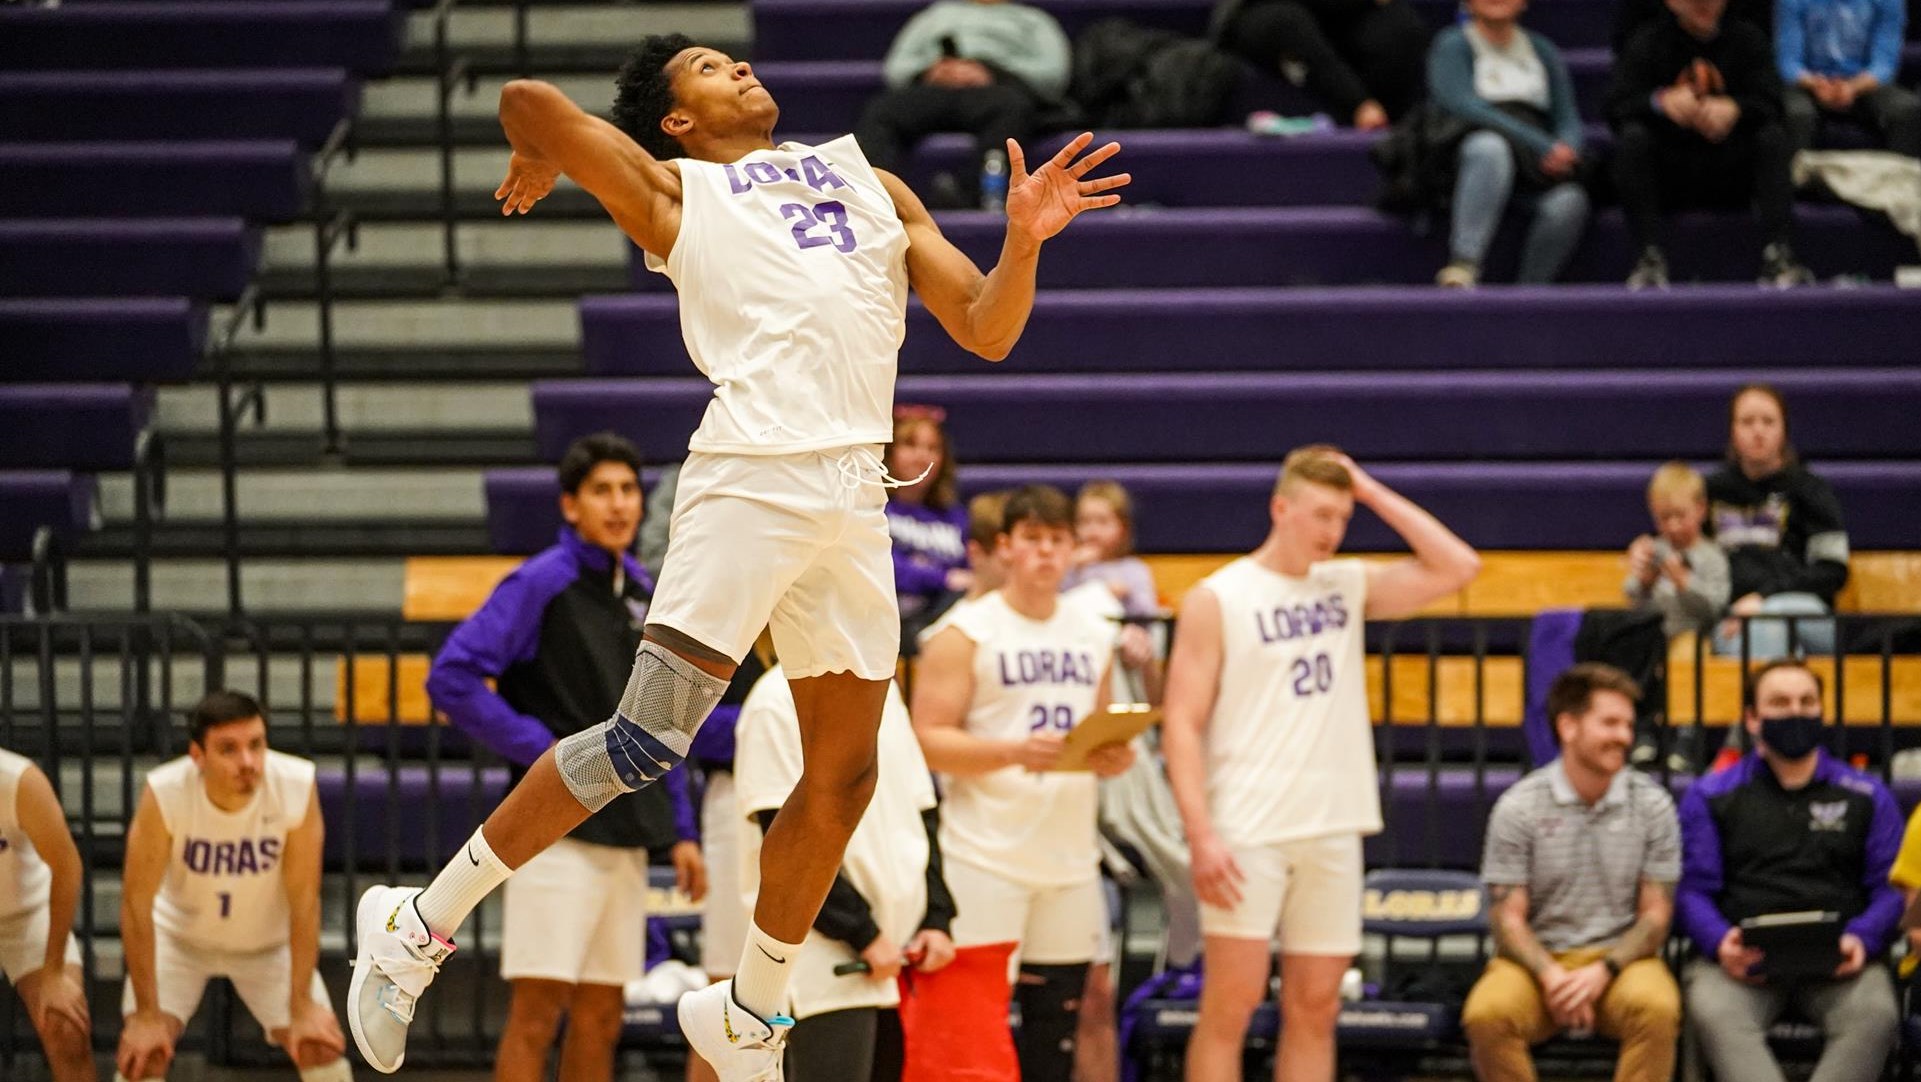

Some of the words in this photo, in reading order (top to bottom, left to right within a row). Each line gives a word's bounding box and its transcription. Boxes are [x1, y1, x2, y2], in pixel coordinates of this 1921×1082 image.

[723, 154, 857, 195] LOA
[779, 200, 857, 253] 23
[1291, 653, 1332, 696] 20
[218, 891, 232, 917] 1
